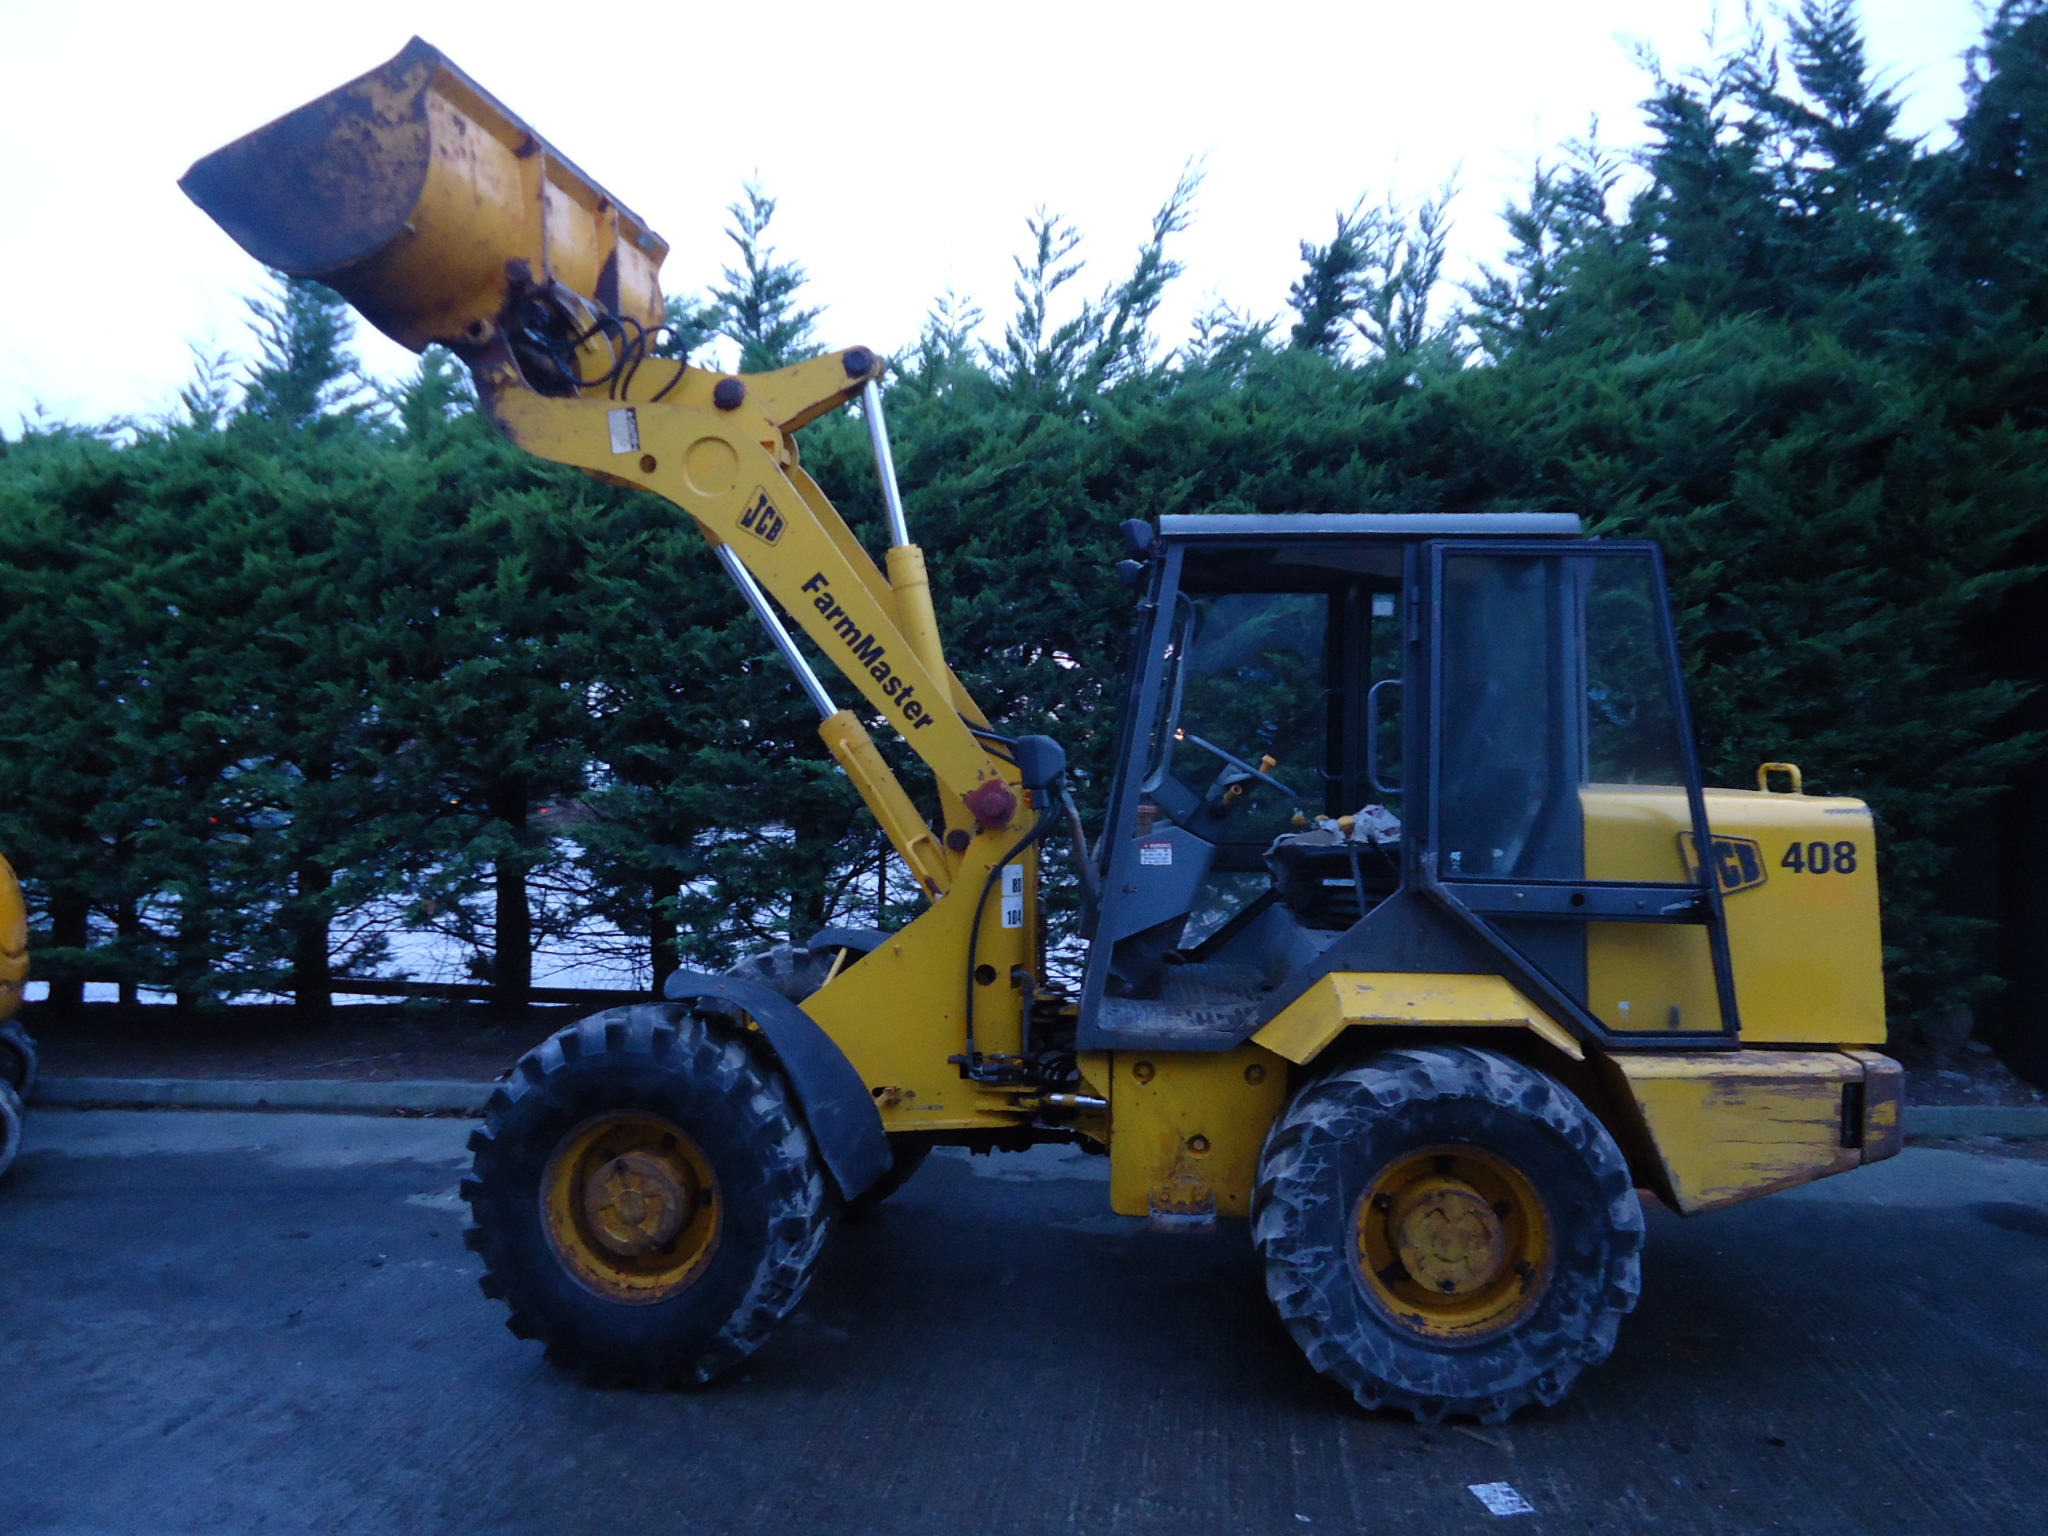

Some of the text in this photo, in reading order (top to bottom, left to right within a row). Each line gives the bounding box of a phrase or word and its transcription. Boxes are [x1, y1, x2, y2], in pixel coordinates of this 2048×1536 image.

[740, 493, 784, 542] JCB
[801, 571, 934, 730] FarmMaster
[1692, 838, 1760, 888] CB
[1781, 841, 1857, 875] 408
